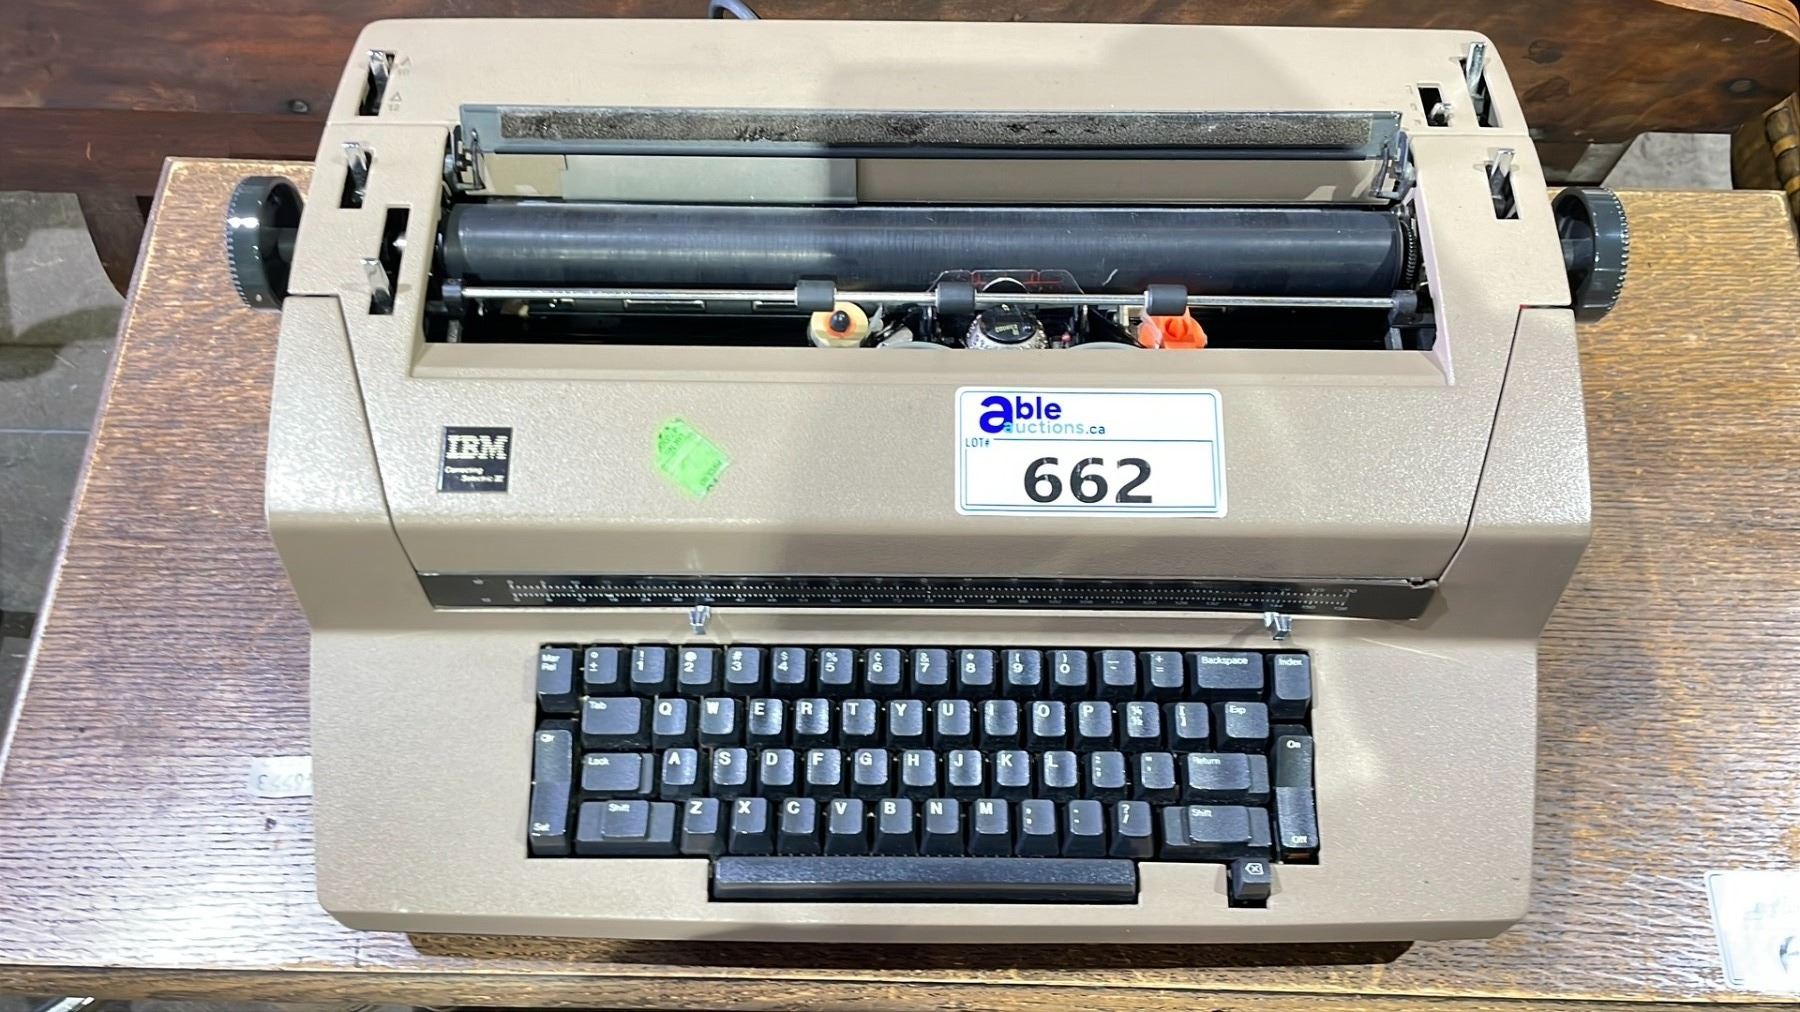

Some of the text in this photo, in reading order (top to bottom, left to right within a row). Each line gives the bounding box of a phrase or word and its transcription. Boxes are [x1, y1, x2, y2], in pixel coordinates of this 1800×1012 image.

[979, 395, 1062, 434] able
[1003, 420, 1106, 435] auctions.ca
[446, 434, 509, 460] IBM
[965, 438, 990, 448] LOT#
[1024, 457, 1153, 504] 662
[826, 652, 838, 662] %
[1155, 655, 1164, 664] +
[1202, 656, 1249, 667] Backspace
[1278, 658, 1303, 666] Index
[636, 661, 644, 671] 1
[684, 662, 694, 672] 2
[731, 661, 742, 671] 3
[778, 661, 788, 671] 4
[825, 662, 835, 672] 5
[872, 662, 883, 672] 6
[920, 662, 930, 673] 7
[965, 663, 976, 673] 8
[1012, 663, 1023, 673] 9
[1059, 663, 1070, 674] 0
[588, 701, 607, 710] Tab
[658, 702, 672, 717] Q
[706, 702, 720, 715] W
[754, 702, 765, 715] E
[801, 702, 813, 715] R
[848, 703, 859, 715] T
[895, 703, 907, 716] Y
[942, 703, 954, 716] U
[989, 703, 994, 716] I
[1037, 704, 1050, 718] O
[1083, 705, 1094, 717] P
[1229, 706, 1246, 716] Exp
[1286, 740, 1301, 749] On
[588, 757, 610, 766] Lock
[668, 752, 681, 765] A
[718, 752, 731, 766] S
[765, 753, 778, 766] D
[812, 753, 824, 765] F
[859, 752, 873, 766] G
[907, 754, 920, 766] H
[953, 754, 964, 767] J
[1001, 754, 1013, 767] K
[1048, 755, 1058, 768] L
[1192, 757, 1221, 765] Return
[608, 803, 630, 813] Shift
[690, 802, 702, 815] Z
[738, 802, 751, 815] X
[787, 801, 800, 815] C
[834, 802, 848, 815] V
[884, 802, 896, 815] B
[930, 802, 943, 815] N
[979, 802, 993, 815] M
[1121, 804, 1130, 814] ?
[1191, 808, 1212, 818] Shift
[1291, 835, 1307, 844] Off
